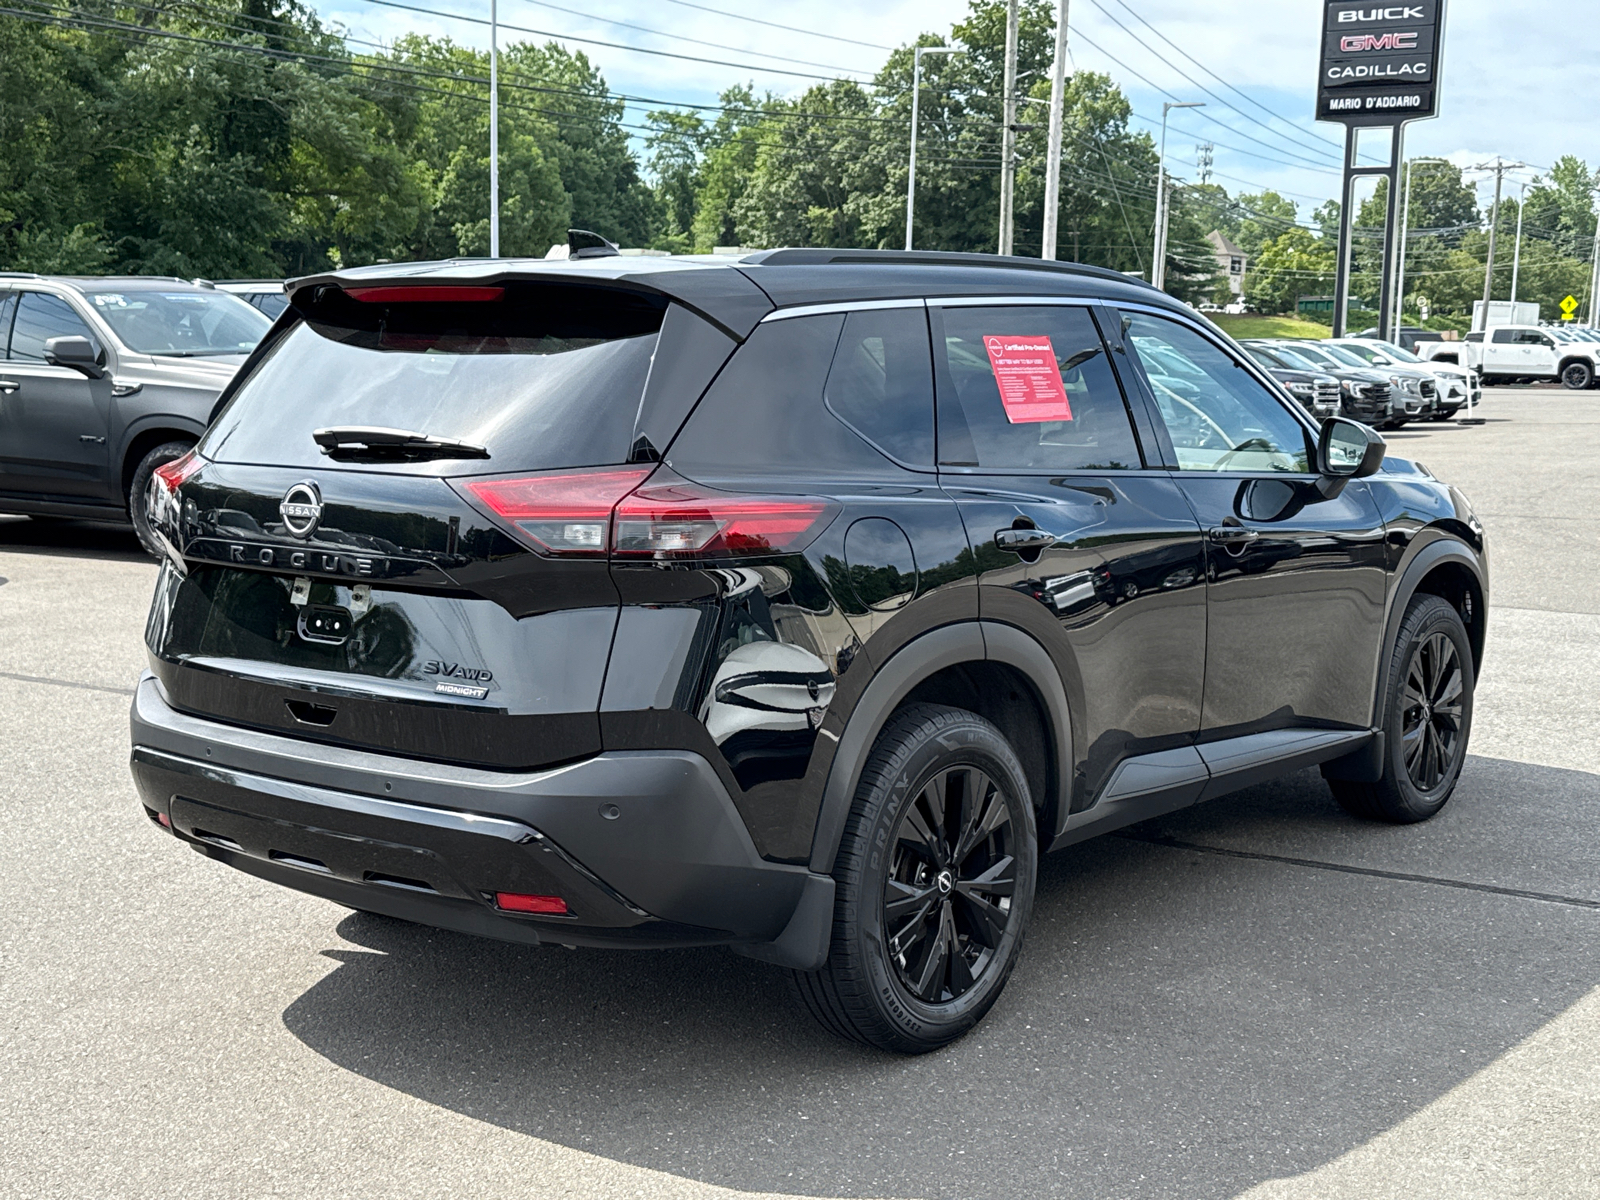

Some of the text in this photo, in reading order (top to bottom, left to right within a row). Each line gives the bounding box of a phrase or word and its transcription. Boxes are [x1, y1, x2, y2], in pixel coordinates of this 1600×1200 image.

[1337, 6, 1425, 23] BUICK
[1340, 32, 1418, 52] GMC
[1327, 63, 1427, 79] CADILLAC
[1329, 95, 1421, 110] MARIO D'ADDARIO
[280, 504, 320, 517] NISSAN
[230, 545, 372, 575] ROGUE
[436, 684, 484, 697] MIDNIGHT
[870, 771, 910, 871] PRINX
